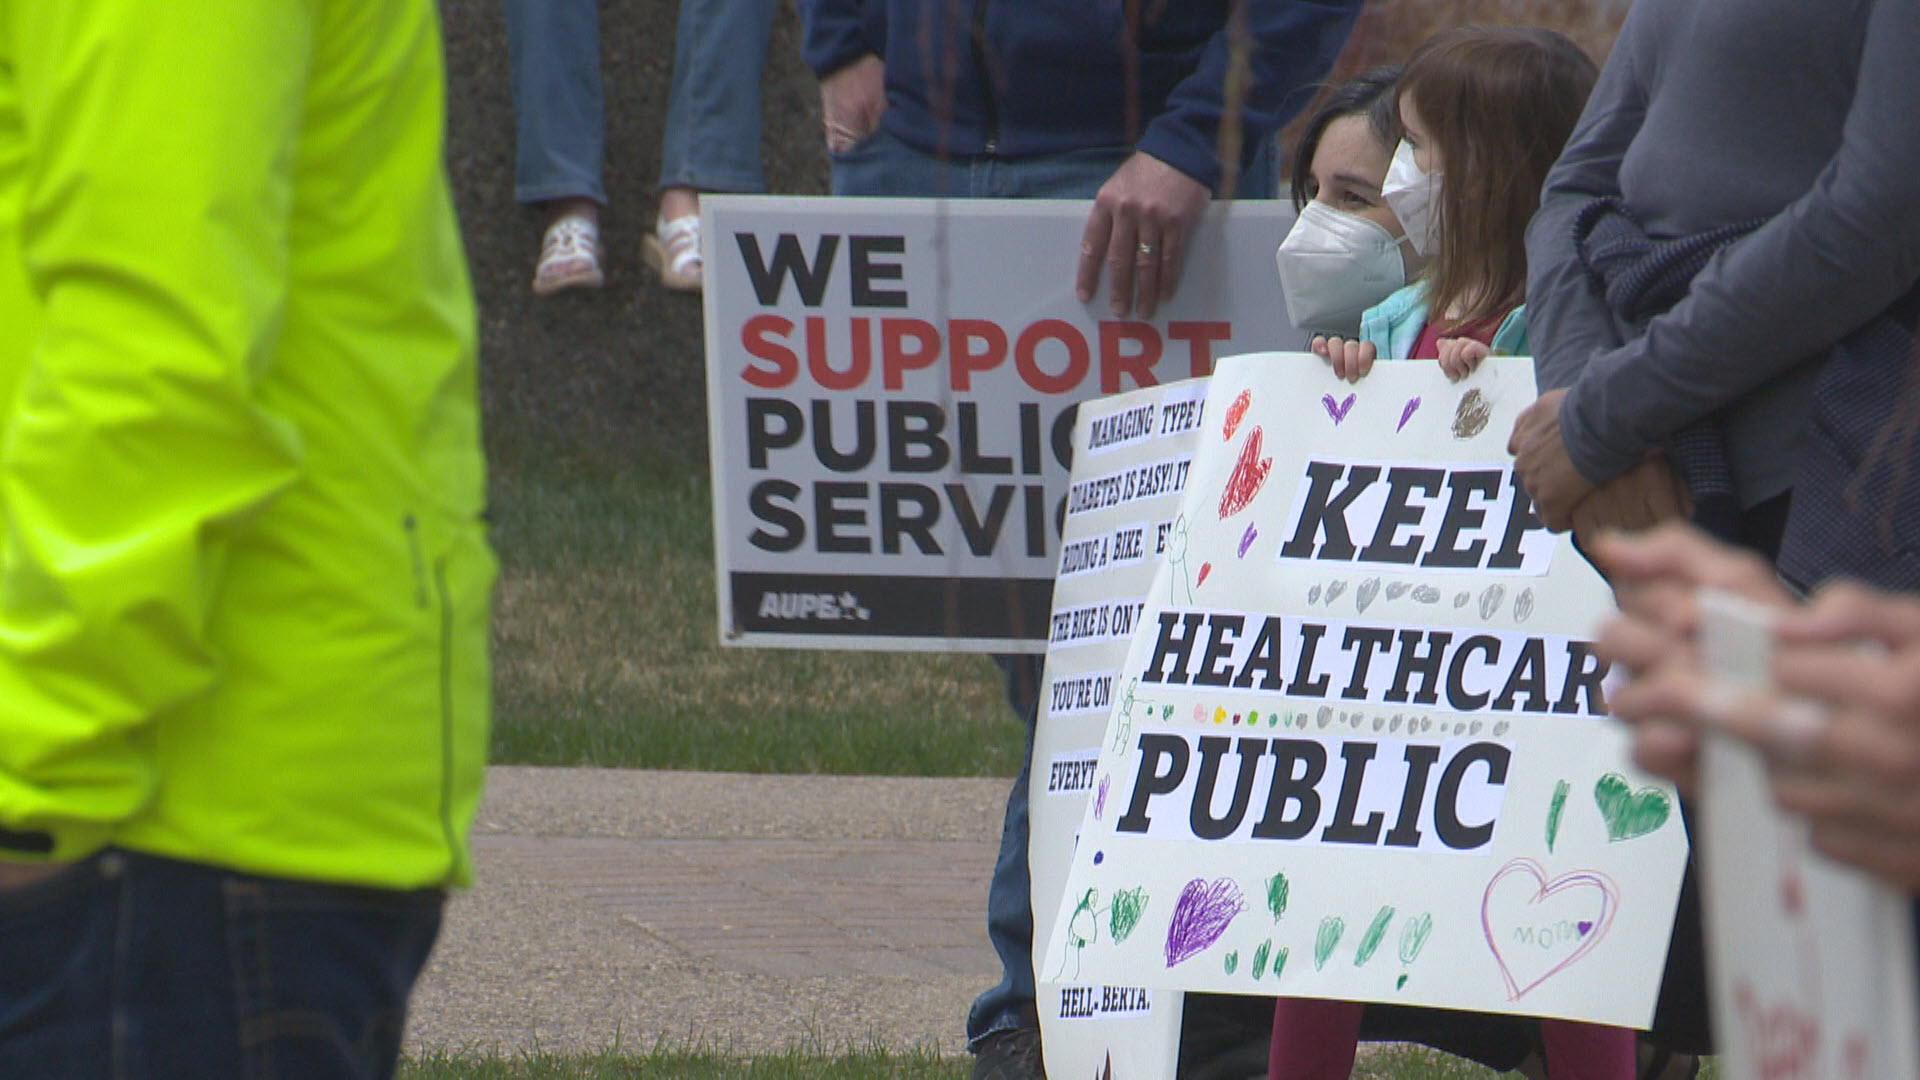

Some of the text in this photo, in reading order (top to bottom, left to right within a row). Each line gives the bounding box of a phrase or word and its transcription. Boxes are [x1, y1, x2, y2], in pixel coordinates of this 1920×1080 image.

[734, 232, 908, 308] WE
[740, 314, 1231, 394] SUPPORT
[1088, 403, 1154, 449] MANAGING
[1161, 399, 1197, 433] TYPE
[1069, 475, 1122, 514] DIABETES
[1122, 470, 1137, 501] IS
[1136, 461, 1173, 498] EASY!
[747, 479, 1068, 557] SERVI
[1060, 538, 1099, 574] RIDING
[1098, 537, 1108, 567] A
[1051, 611, 1071, 643] THE
[1071, 607, 1097, 640] BIKE
[1097, 605, 1109, 636] IS
[1112, 605, 1133, 636] ON
[1141, 611, 1611, 717] HEALTHCAR
[1051, 676, 1112, 712] YOU'RE ON
[1049, 760, 1098, 792] EVERYT
[1116, 732, 1512, 850] PUBLIC
